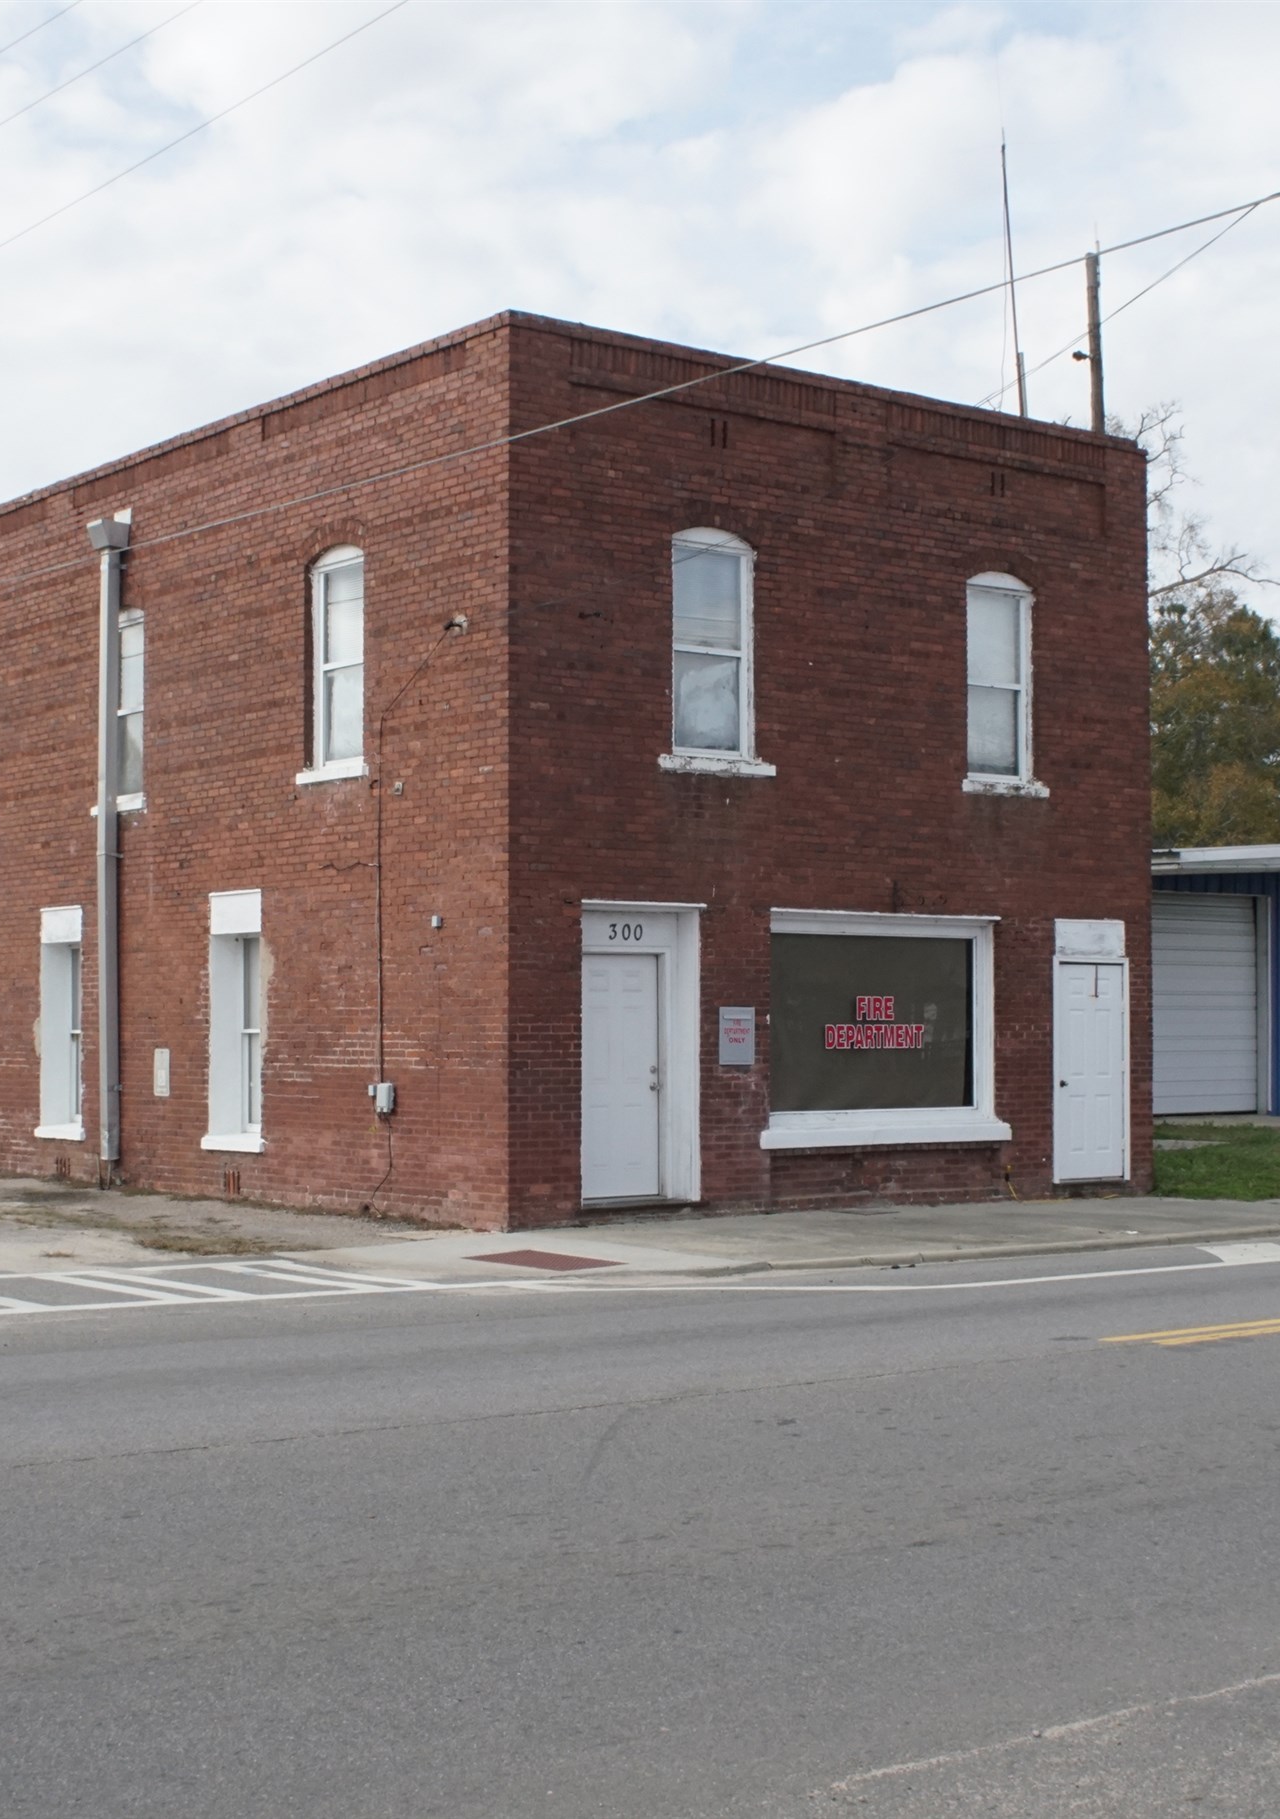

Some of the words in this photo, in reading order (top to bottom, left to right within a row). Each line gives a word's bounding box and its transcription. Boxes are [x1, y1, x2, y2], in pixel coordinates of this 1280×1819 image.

[608, 922, 643, 942] 300
[856, 996, 894, 1021] FIRE
[728, 1036, 746, 1044] ONLY
[825, 1024, 924, 1049] DEPARTMENT
